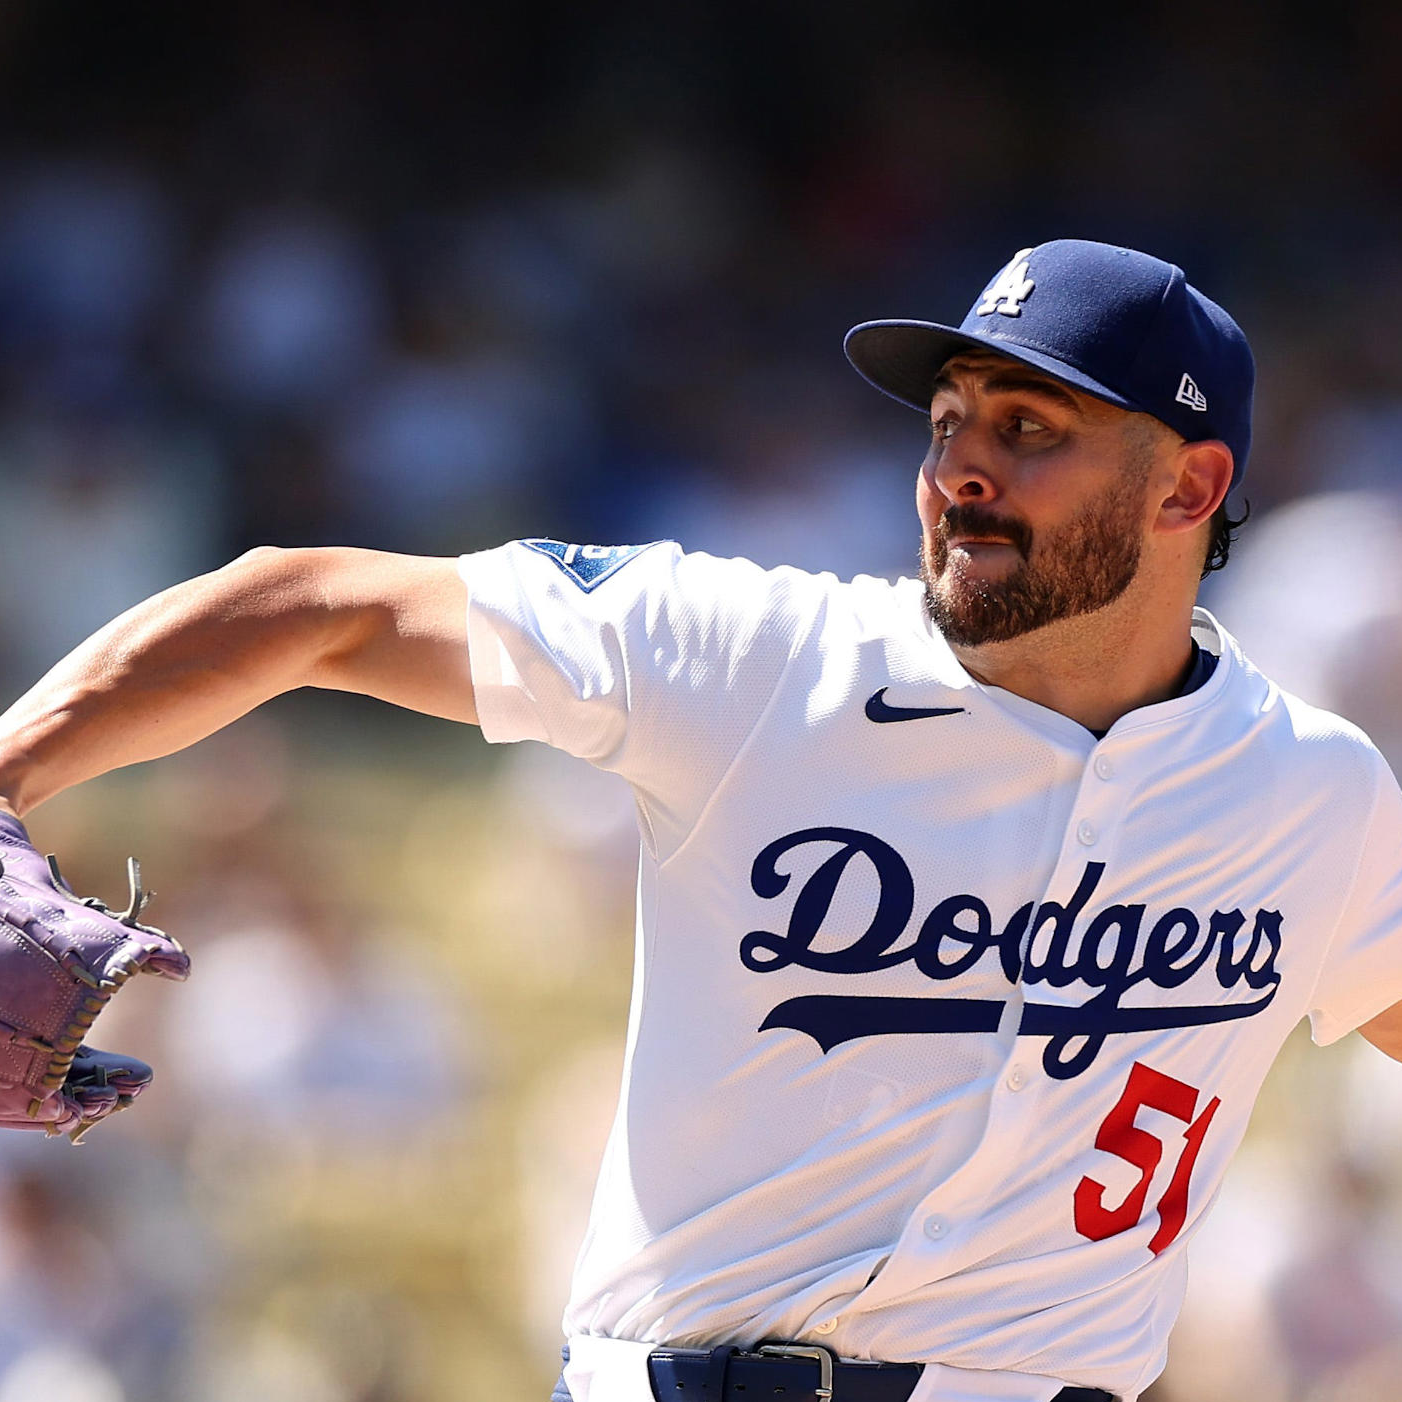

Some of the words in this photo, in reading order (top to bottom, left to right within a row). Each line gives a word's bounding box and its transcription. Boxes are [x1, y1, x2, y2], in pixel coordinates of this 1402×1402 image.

[976, 248, 1035, 317] LA
[739, 826, 1284, 1081] Dodgers
[1073, 1061, 1221, 1256] 51
